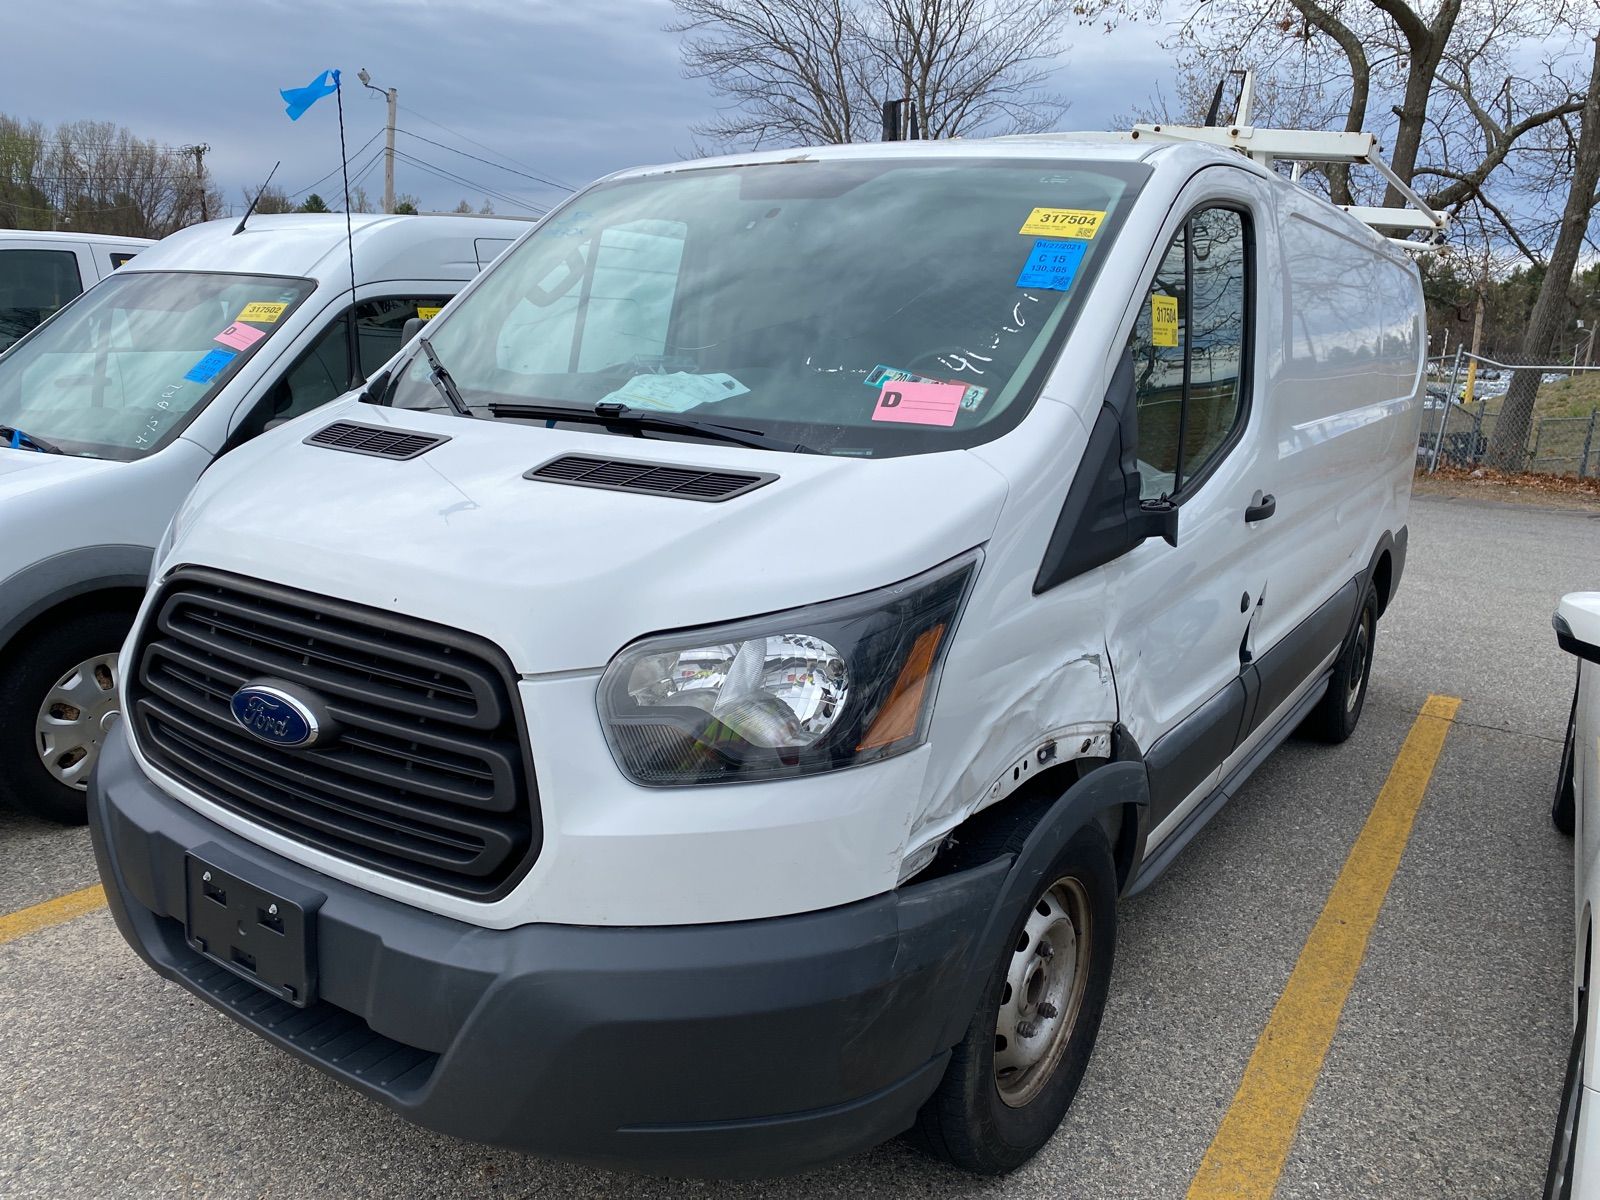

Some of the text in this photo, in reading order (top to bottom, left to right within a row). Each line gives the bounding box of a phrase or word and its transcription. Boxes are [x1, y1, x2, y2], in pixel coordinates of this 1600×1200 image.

[1040, 213, 1097, 225] 317504
[1039, 254, 1066, 263] C 15
[249, 306, 282, 314] 317502
[1156, 306, 1176, 323] 317504
[224, 327, 237, 335] D
[880, 391, 903, 408] D
[965, 390, 979, 408] 3
[243, 696, 290, 737] Ford
